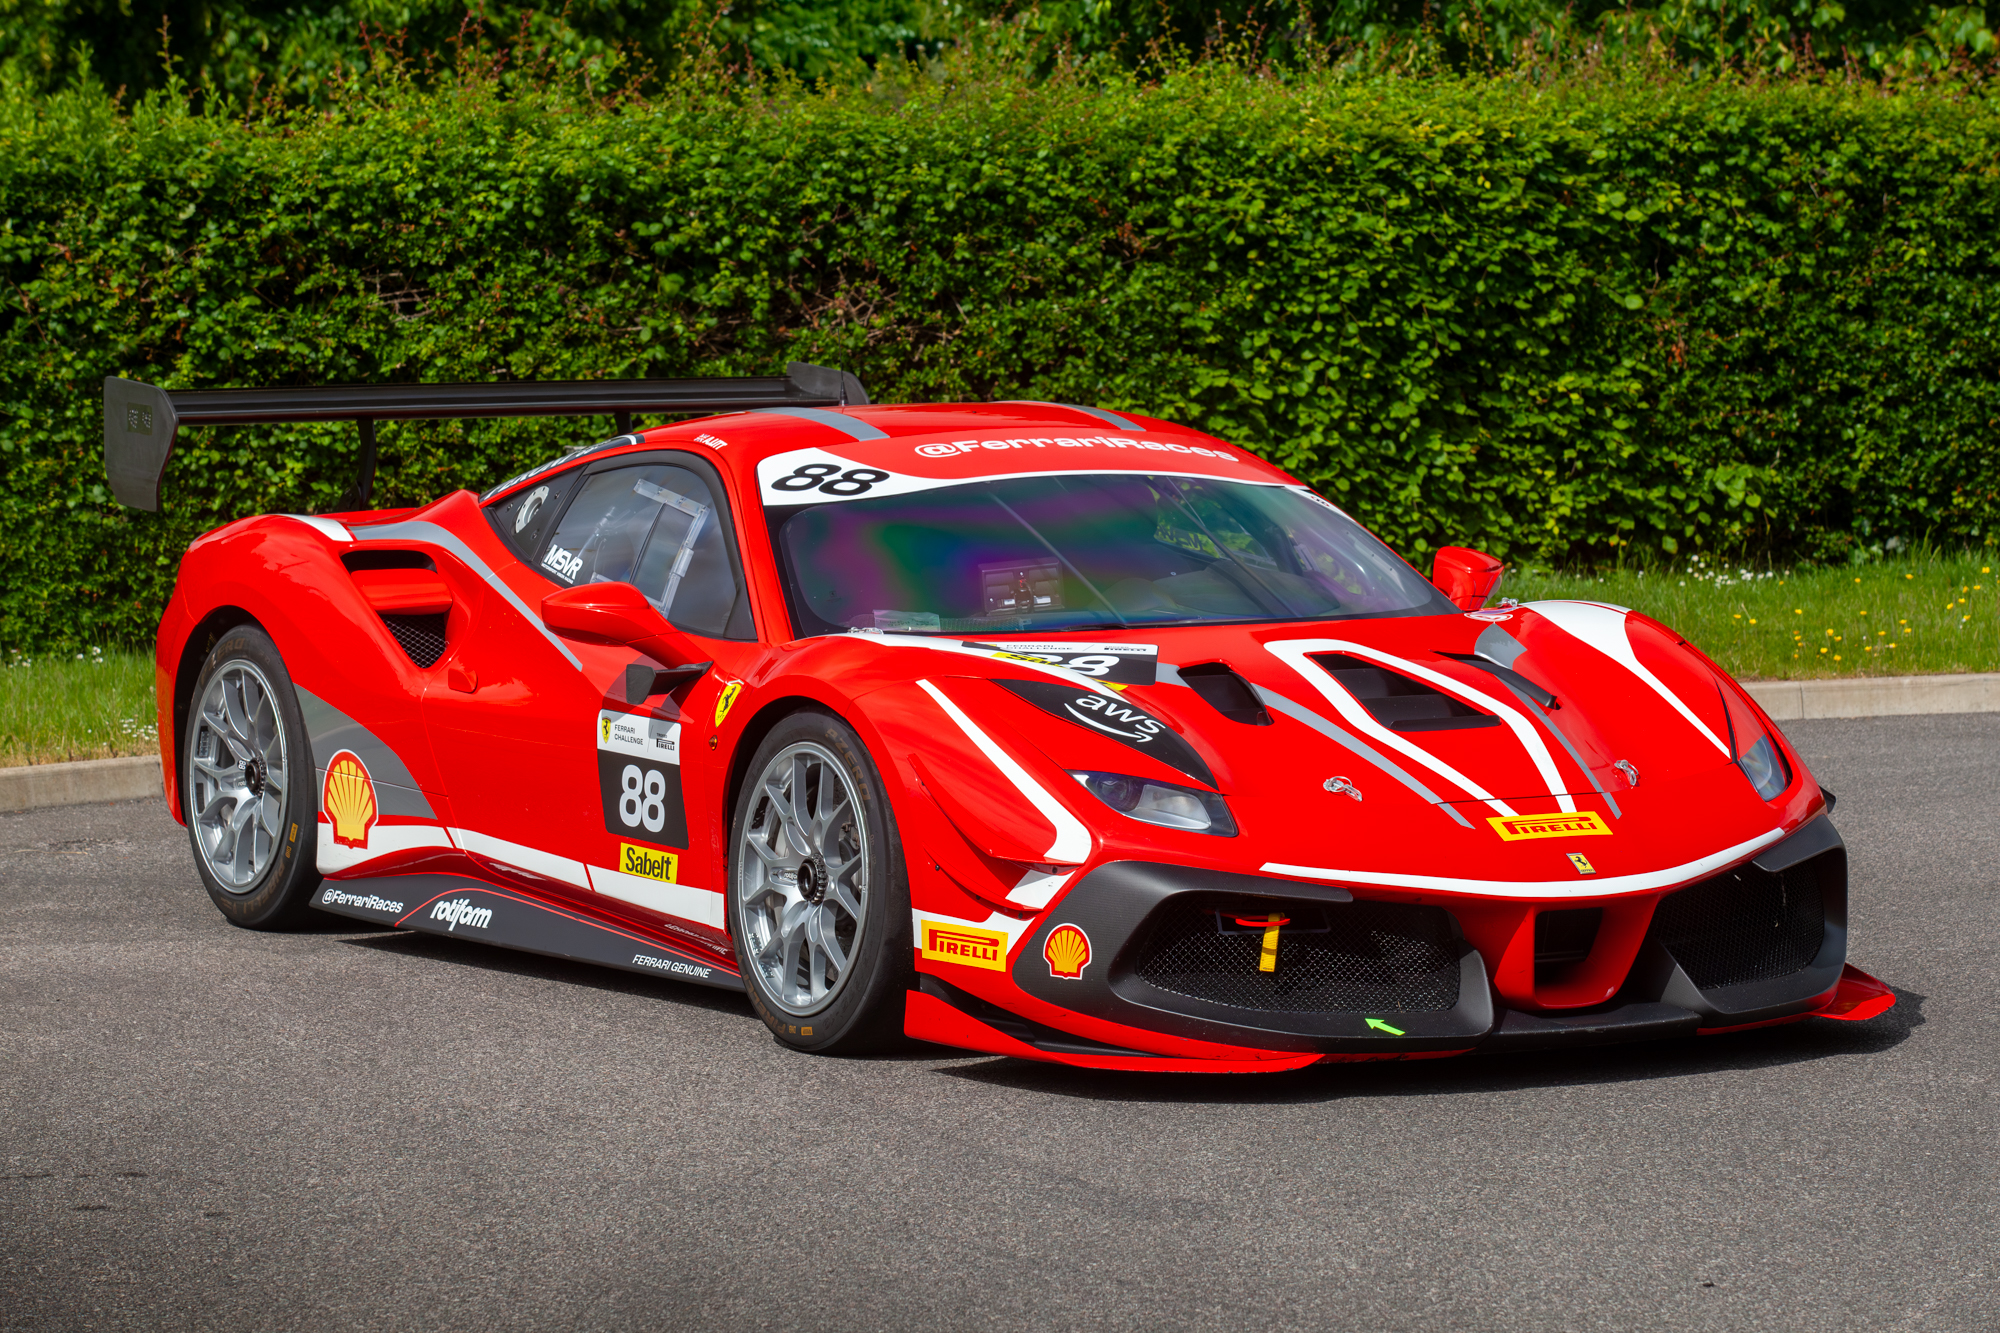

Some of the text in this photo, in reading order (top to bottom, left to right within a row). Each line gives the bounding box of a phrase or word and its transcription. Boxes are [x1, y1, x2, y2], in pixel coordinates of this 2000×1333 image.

[914, 436, 1239, 462] @FerrariRaces
[771, 463, 890, 496] 88
[543, 544, 583, 580] MSVR
[1075, 695, 1166, 733] aws
[614, 724, 636, 734] FERRARI
[614, 734, 644, 746] CHALLENGE
[656, 738, 675, 751] PIRELLI
[619, 764, 666, 833] 88
[1501, 816, 1598, 835] PIRELLI
[625, 846, 672, 881] Sabelt
[322, 888, 404, 914] @FerrariRaces
[430, 898, 493, 931] rotiform
[929, 928, 999, 961] PIRELLI
[632, 954, 712, 978] FERRARI GENUINE
